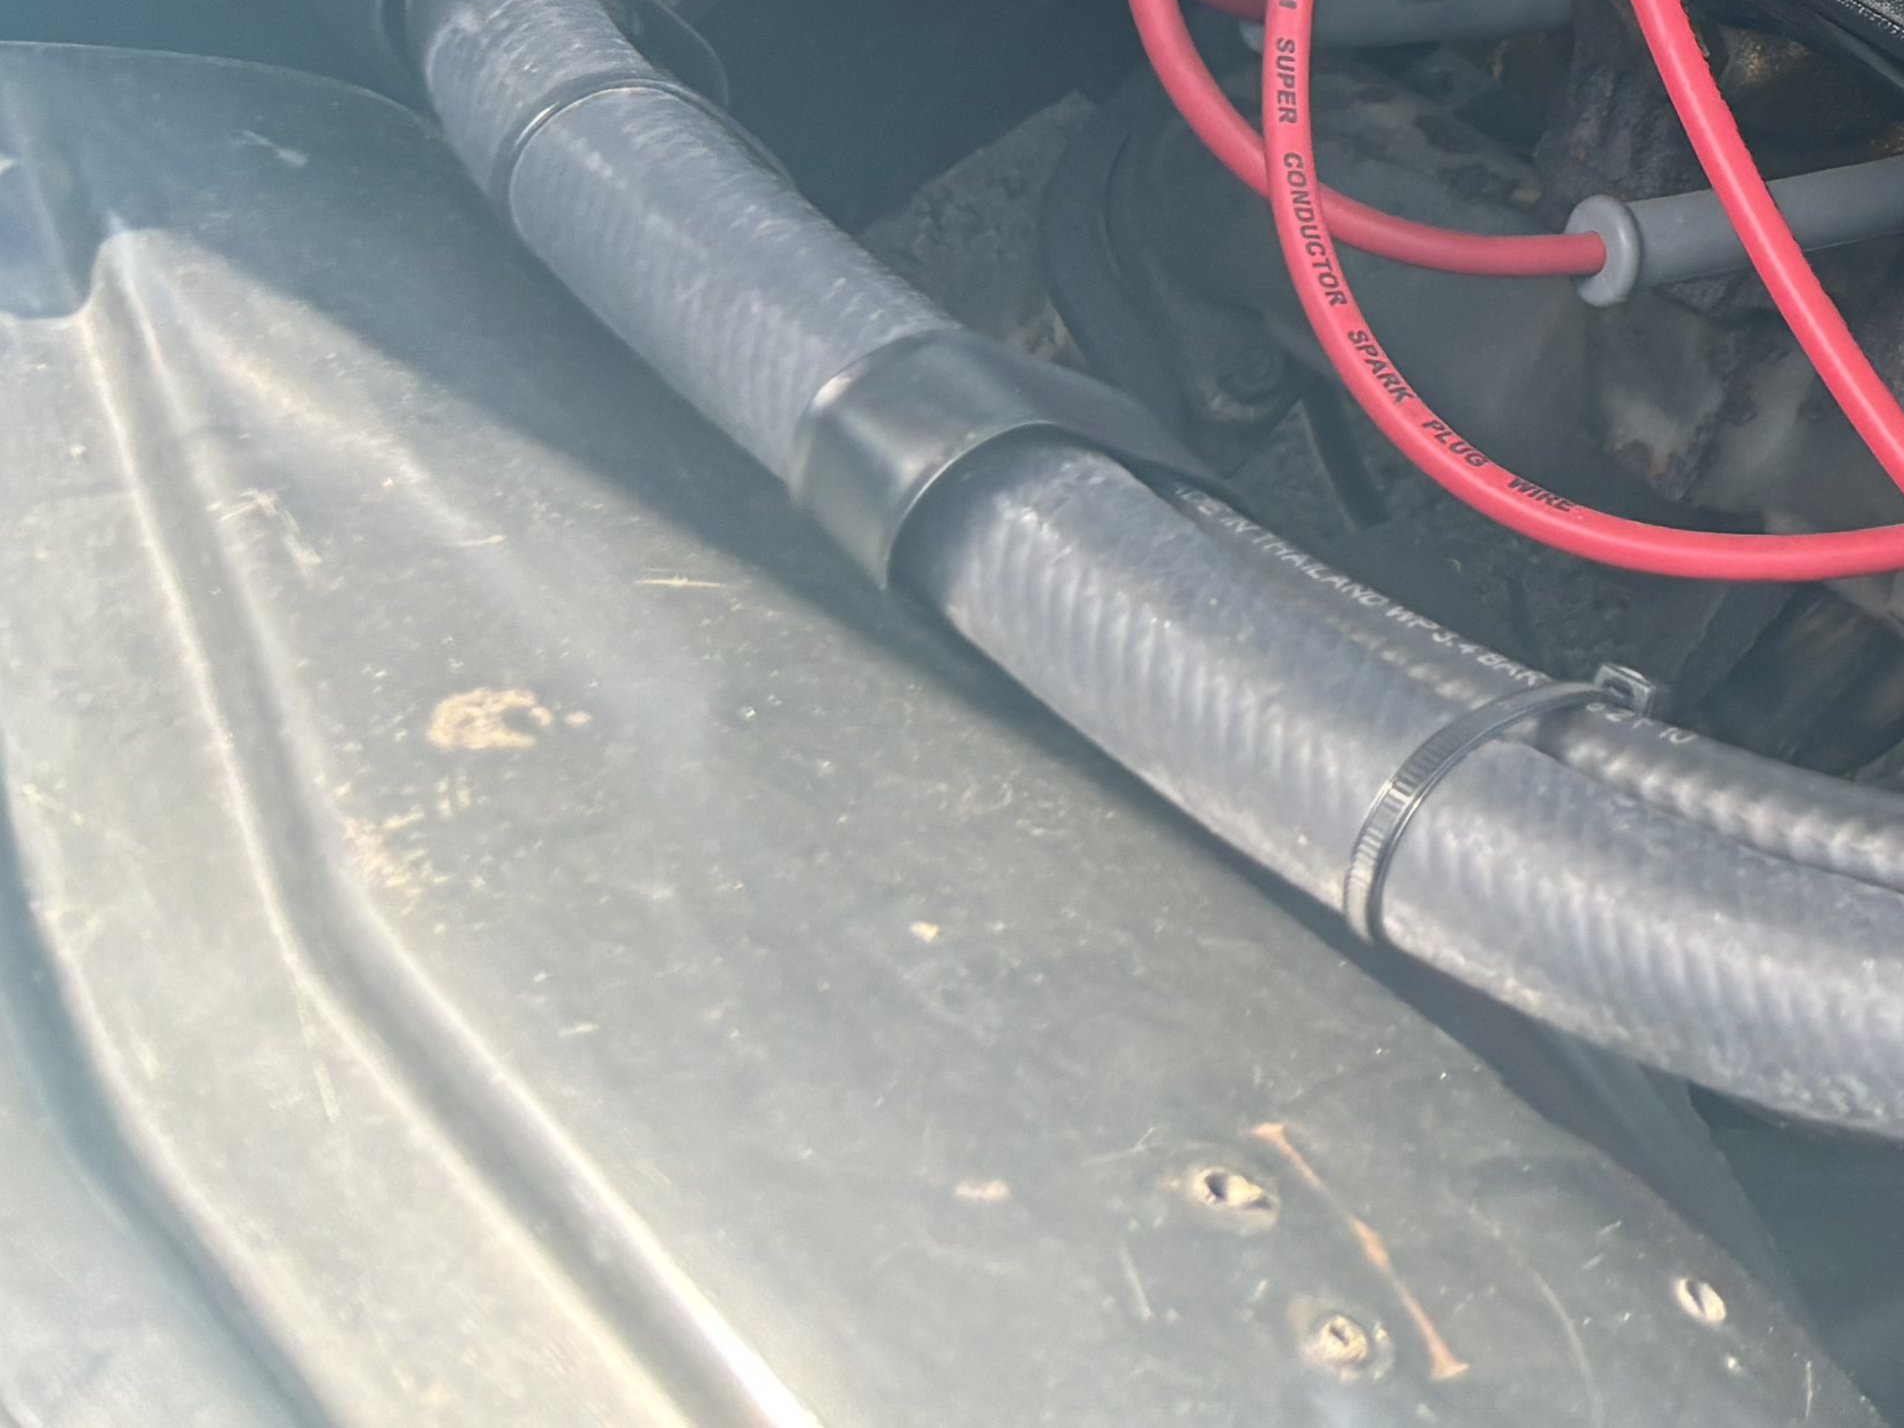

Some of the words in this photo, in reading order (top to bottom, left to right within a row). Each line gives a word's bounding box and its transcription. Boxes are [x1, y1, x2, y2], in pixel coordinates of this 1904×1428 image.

[1275, 36, 1299, 125] SUPER
[1281, 150, 1348, 307] CONDUCTOR
[1346, 327, 1416, 406] SPARK
[1421, 418, 1490, 468] PLUG
[1507, 477, 1576, 514] WIRE
[1252, 531, 1389, 608] THAILAND
